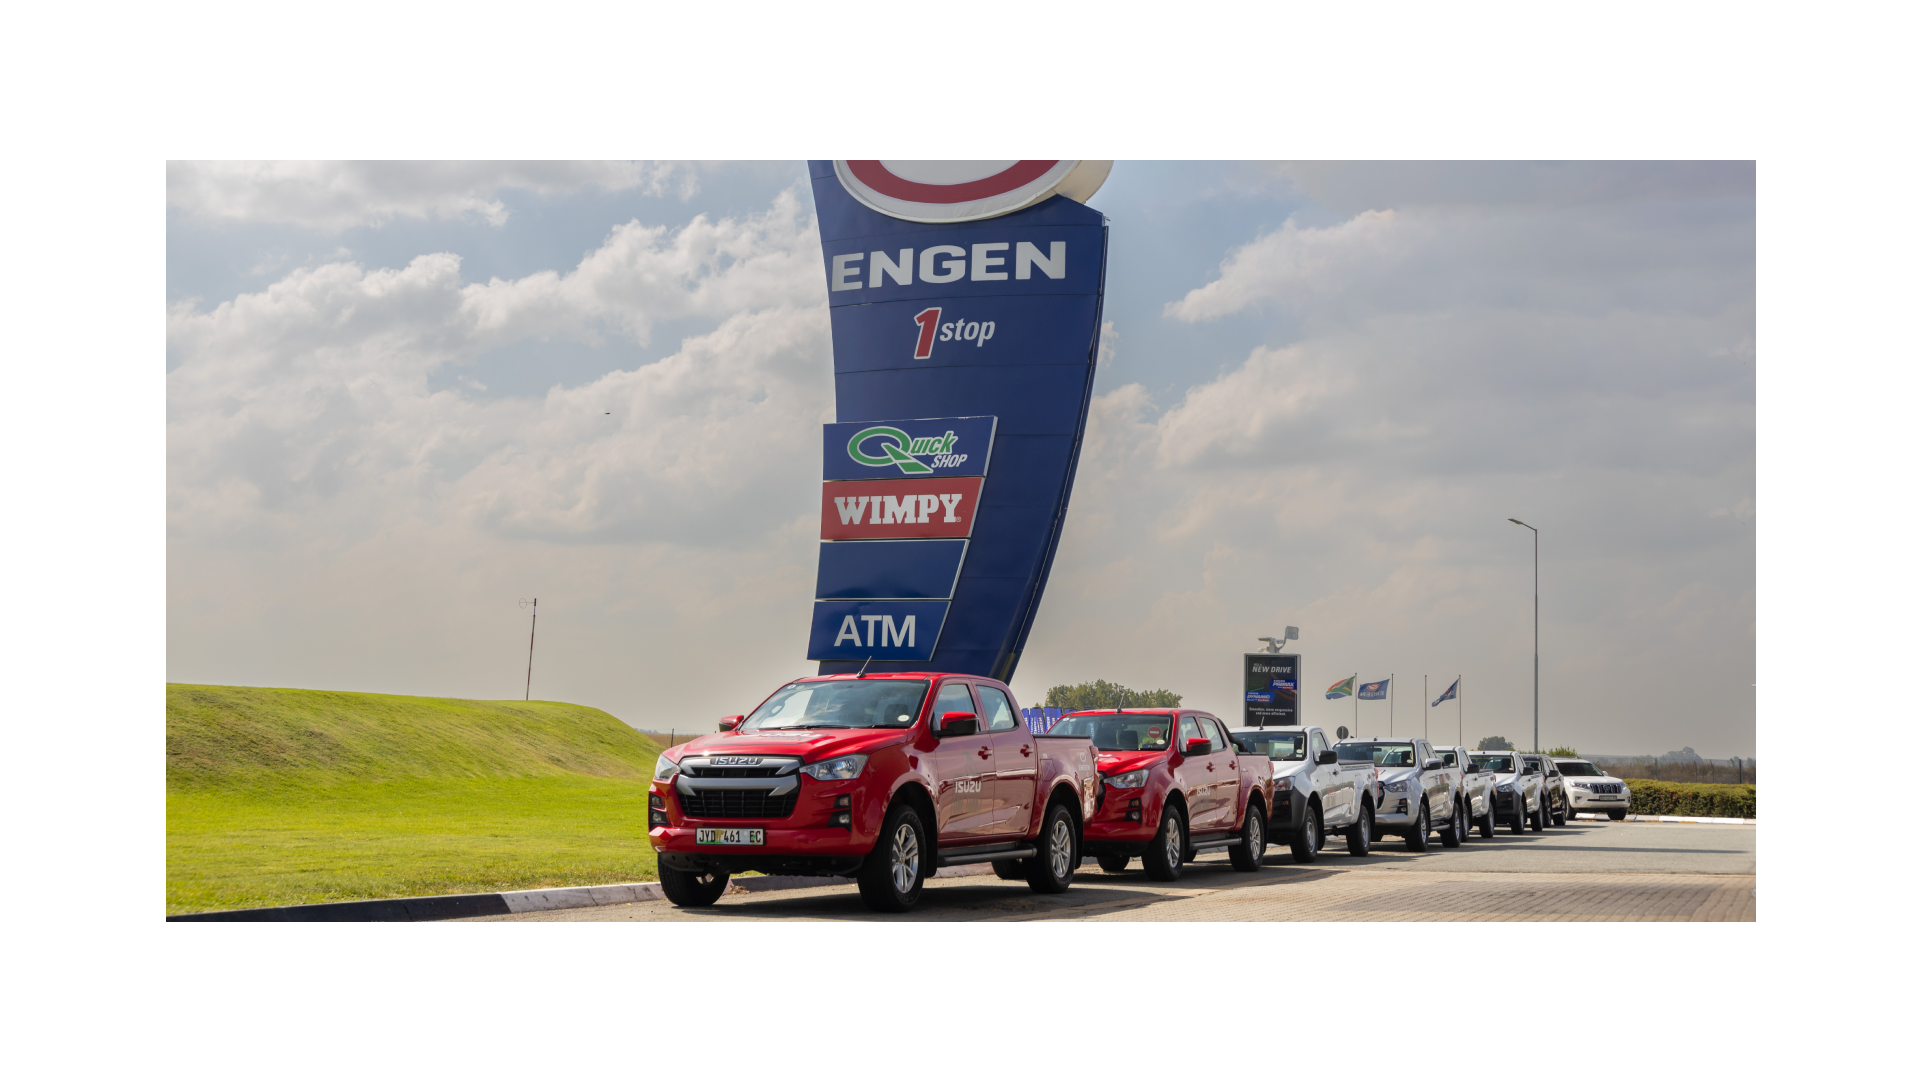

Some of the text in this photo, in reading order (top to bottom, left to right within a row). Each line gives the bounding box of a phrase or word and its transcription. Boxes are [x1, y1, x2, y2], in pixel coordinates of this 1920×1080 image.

[831, 241, 1066, 292] ENGEN
[913, 307, 996, 360] 1 stop
[930, 454, 968, 468] SHOP
[834, 494, 963, 526] WIMPY
[834, 615, 916, 648] ATM
[1270, 666, 1292, 674] DRIVE
[714, 757, 758, 765] ISUZU
[955, 780, 982, 794] ISUZU
[699, 830, 762, 843] JYD 461 EC
